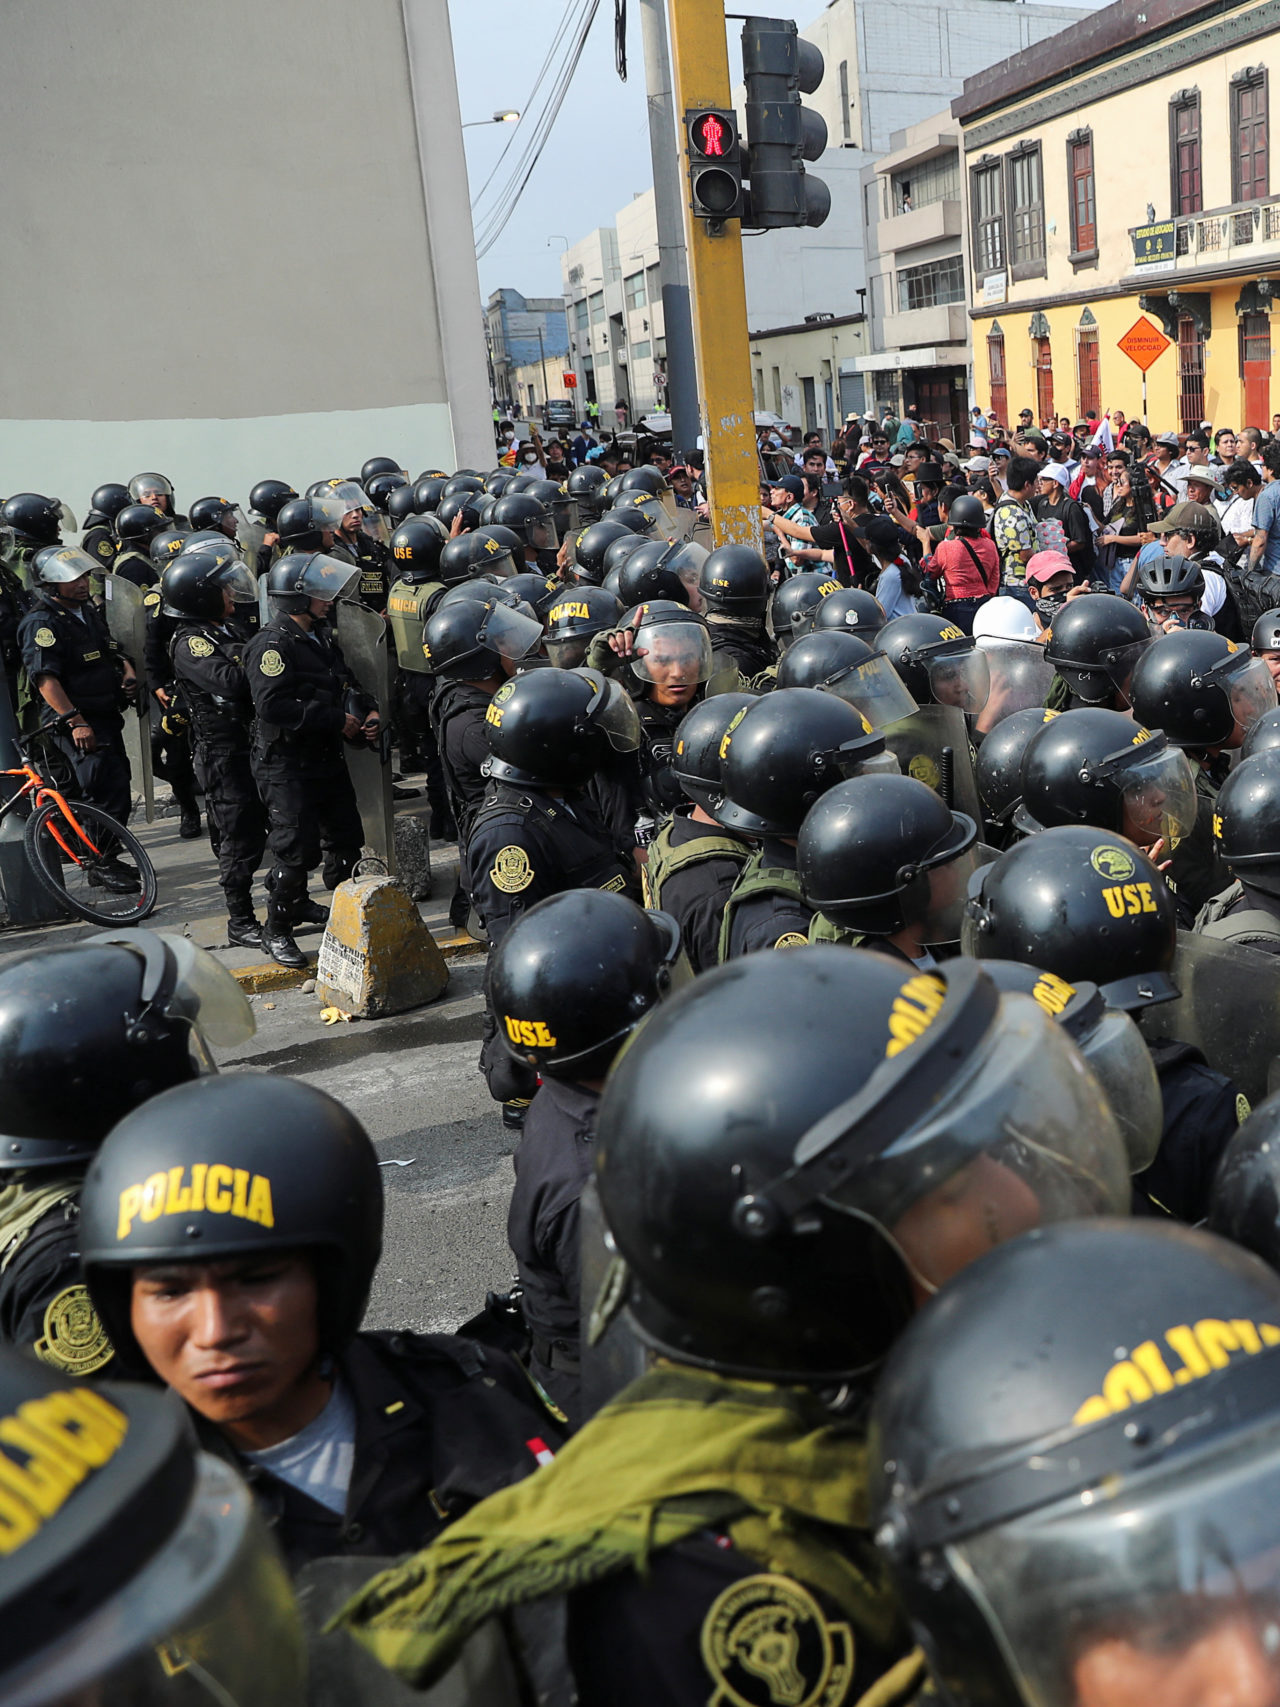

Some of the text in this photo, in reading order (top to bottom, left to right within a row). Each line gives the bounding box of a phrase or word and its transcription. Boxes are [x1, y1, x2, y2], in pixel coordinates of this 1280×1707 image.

[394, 547, 412, 560] USE
[712, 578, 730, 588] USE
[390, 598, 417, 613] POLICIA
[549, 602, 590, 625] POLICIA
[1102, 882, 1158, 918] USE
[504, 1015, 557, 1047] USE
[117, 1163, 275, 1241] POLICIA
